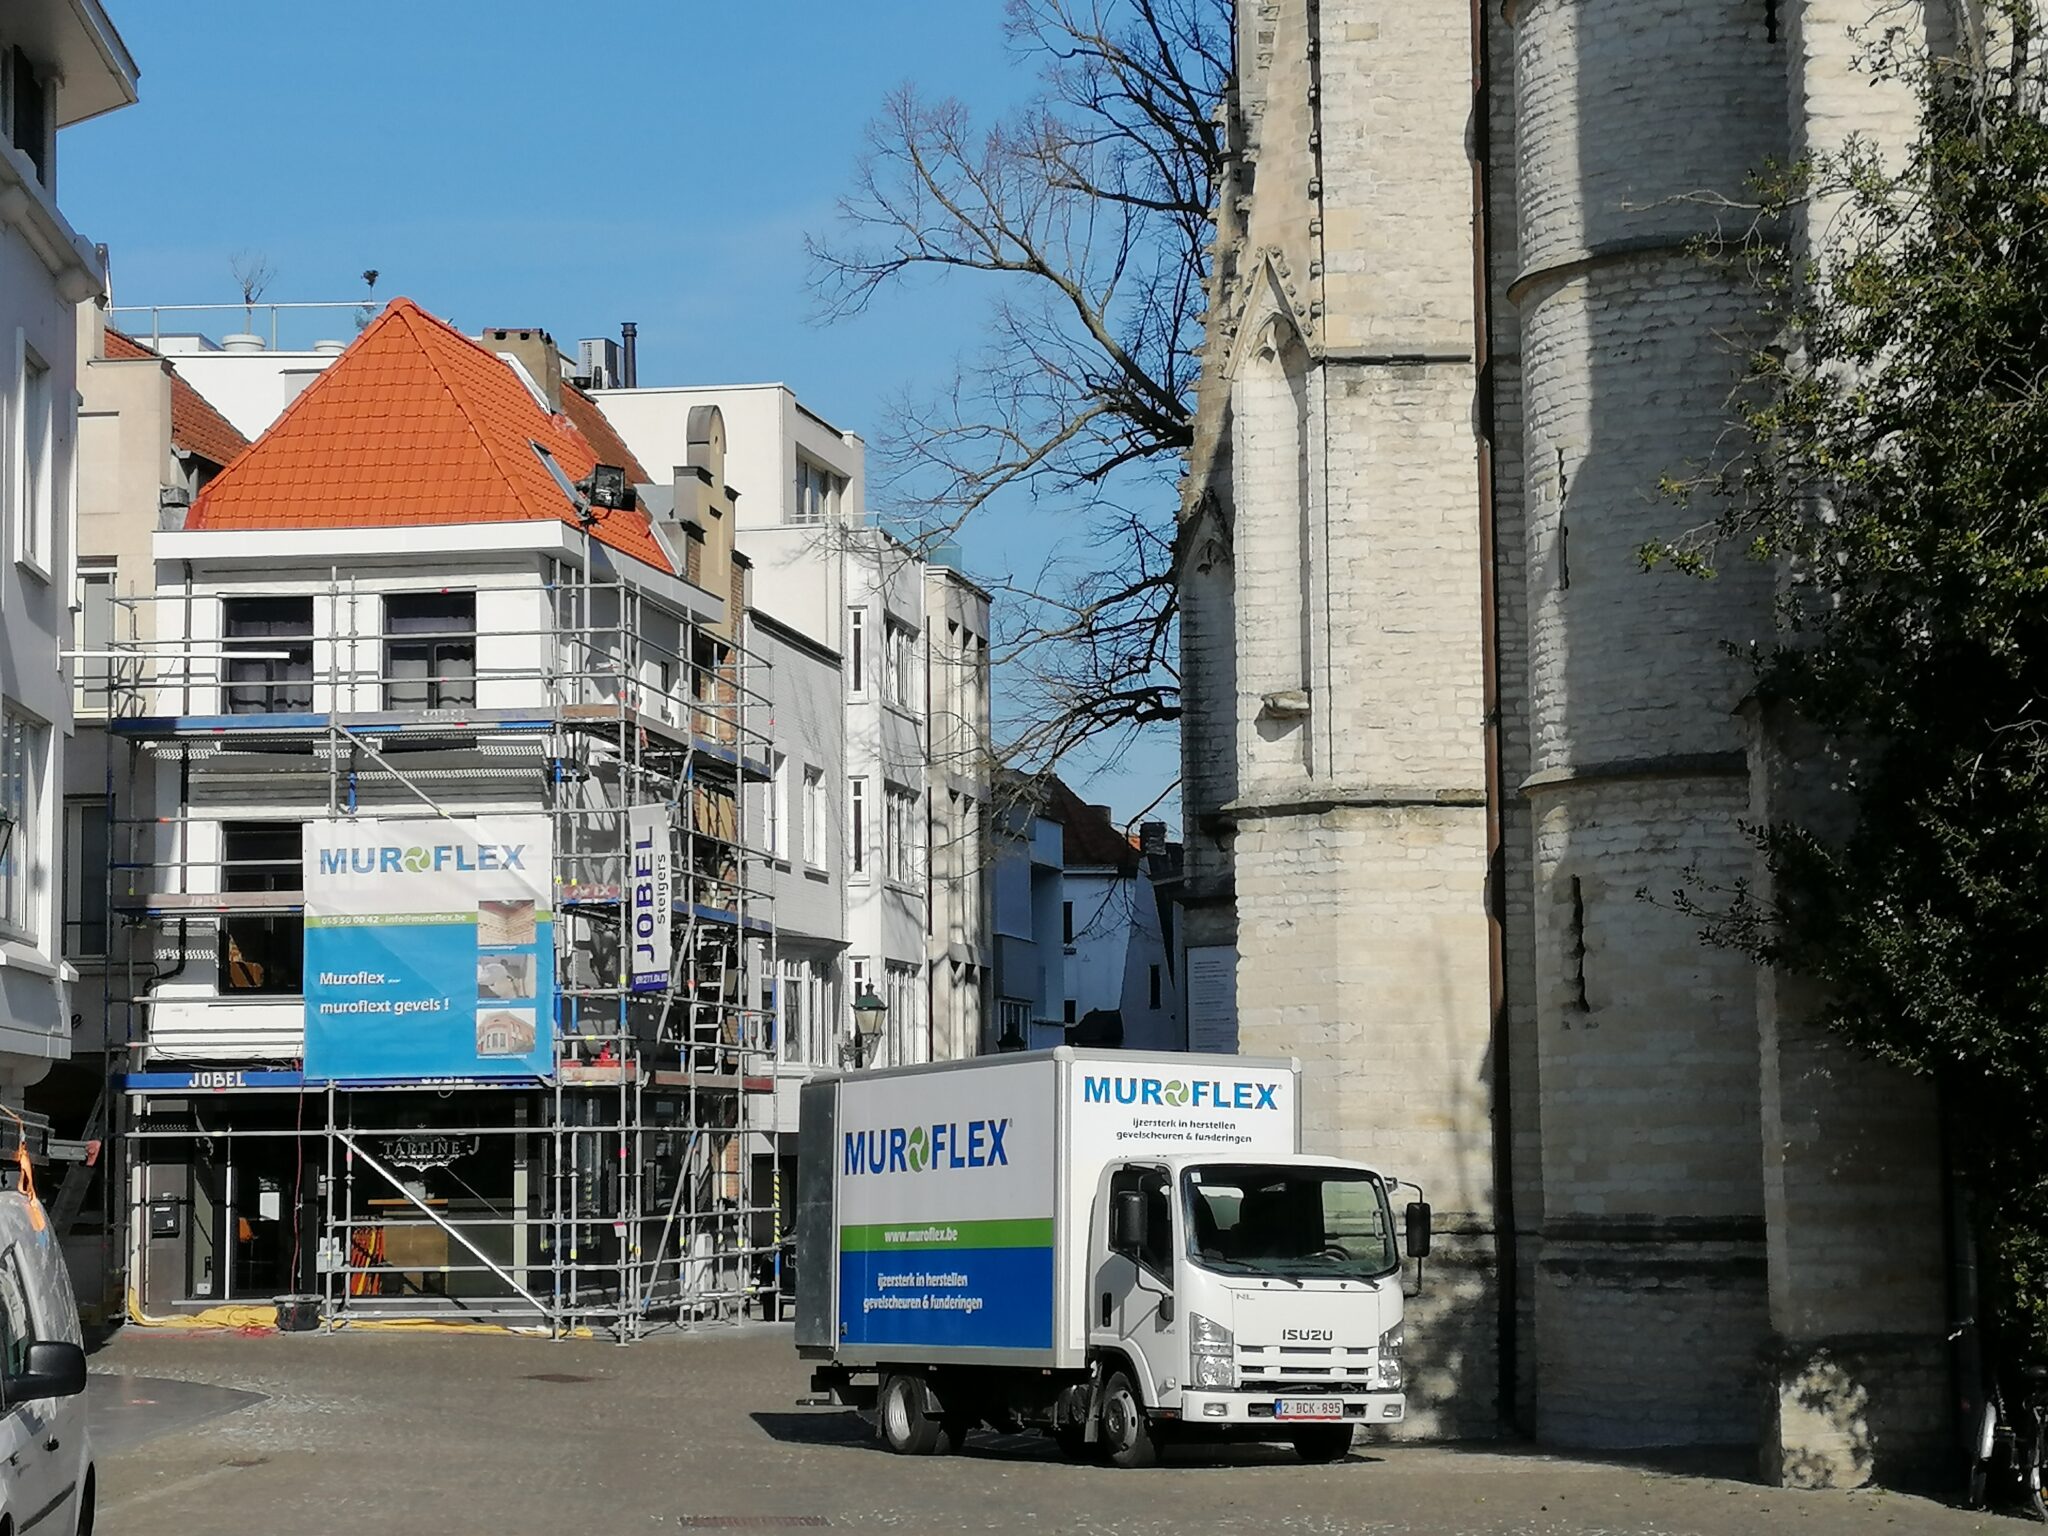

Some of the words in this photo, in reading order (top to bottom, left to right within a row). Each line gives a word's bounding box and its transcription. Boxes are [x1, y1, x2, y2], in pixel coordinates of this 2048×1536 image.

[319, 844, 526, 875] MUROFLEX
[635, 825, 655, 963] JOBEL
[657, 853, 669, 925] Steigers
[367, 915, 379, 923] 42
[385, 913, 467, 923] info@muroflex.be
[319, 971, 385, 985] Muroflex
[320, 1001, 391, 1014] muroflext
[394, 999, 441, 1015] gevels
[188, 1071, 247, 1088] JOBEL
[1084, 1076, 1278, 1110] MUROFLEX
[1132, 1117, 1176, 1129] ijzersterk
[1178, 1118, 1188, 1128] in
[1189, 1119, 1236, 1130] herstellen
[1116, 1130, 1184, 1141] gevelscheuren
[1195, 1131, 1252, 1145] funderingen
[383, 1141, 460, 1155] TARTINE
[844, 1118, 1009, 1176] MUROFLEX
[884, 1226, 958, 1243] www.muroflex.be
[877, 1272, 914, 1290] ijzersterk
[916, 1272, 924, 1287] in
[926, 1271, 968, 1287] herstellen
[863, 1296, 922, 1314] gevelscheuren
[930, 1293, 983, 1314] funderingen
[1282, 1328, 1333, 1341] ISUZU
